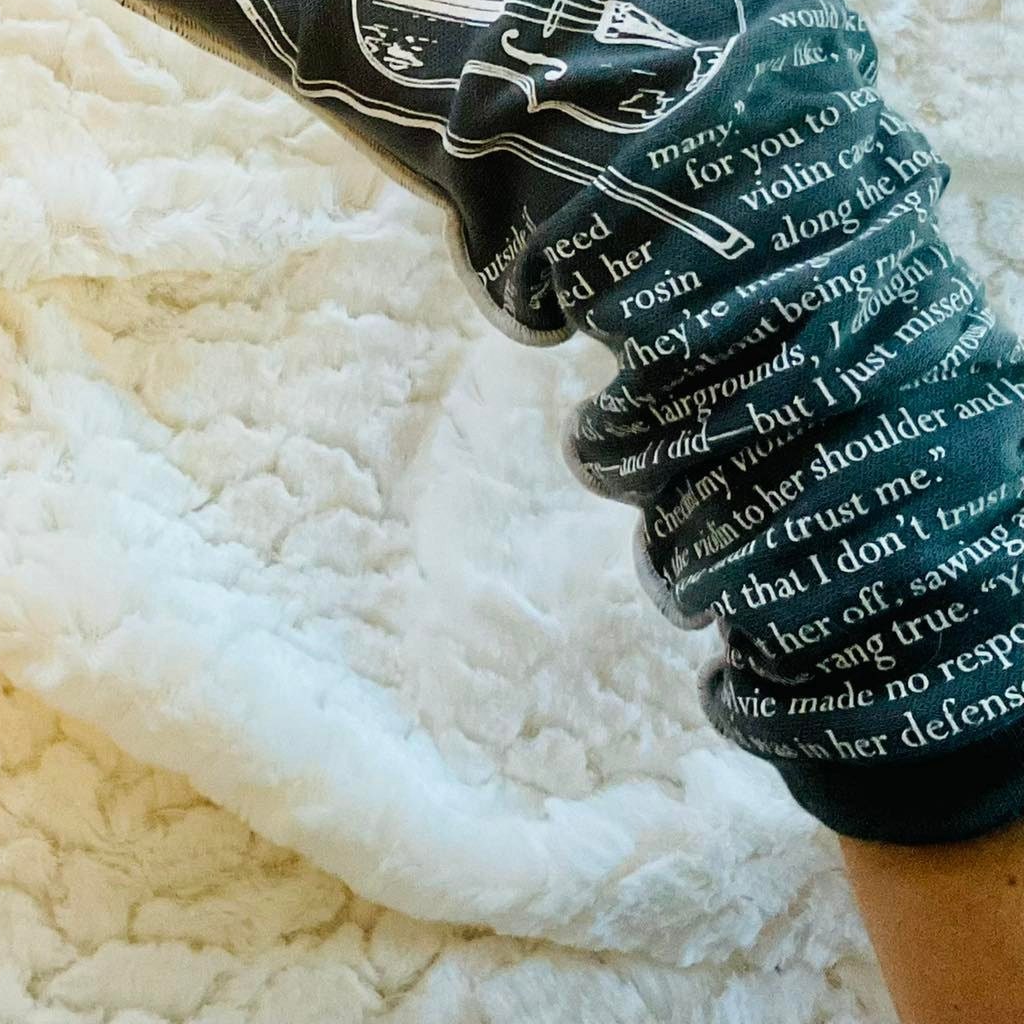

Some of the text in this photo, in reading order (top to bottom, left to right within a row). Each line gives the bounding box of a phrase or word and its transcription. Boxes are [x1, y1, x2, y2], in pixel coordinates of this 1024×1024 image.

[685, 154, 734, 190] for
[741, 126, 805, 175] you
[805, 107, 840, 133] to
[739, 160, 834, 211] violin
[544, 212, 612, 265] need
[771, 177, 896, 252] along the
[599, 240, 652, 282] her
[619, 269, 703, 319] rosin
[771, 264, 873, 323] being
[814, 376, 837, 407] I
[836, 343, 897, 405] just
[895, 277, 974, 345] missed
[649, 341, 820, 425] fairgrounds,
[695, 465, 732, 501] my
[733, 505, 765, 530] to
[753, 470, 803, 513] her
[810, 407, 948, 481] shoulder
[954, 383, 1013, 419] and
[785, 446, 946, 542] trust me.”
[741, 568, 809, 609] that
[809, 554, 831, 585] I
[837, 514, 931, 573] don't
[768, 524, 1024, 654] her off, sawing
[816, 632, 896, 674] rang
[892, 602, 979, 645] true.
[788, 680, 873, 715] made
[886, 673, 929, 701] no
[825, 729, 888, 759] her
[901, 681, 1024, 748] defens
